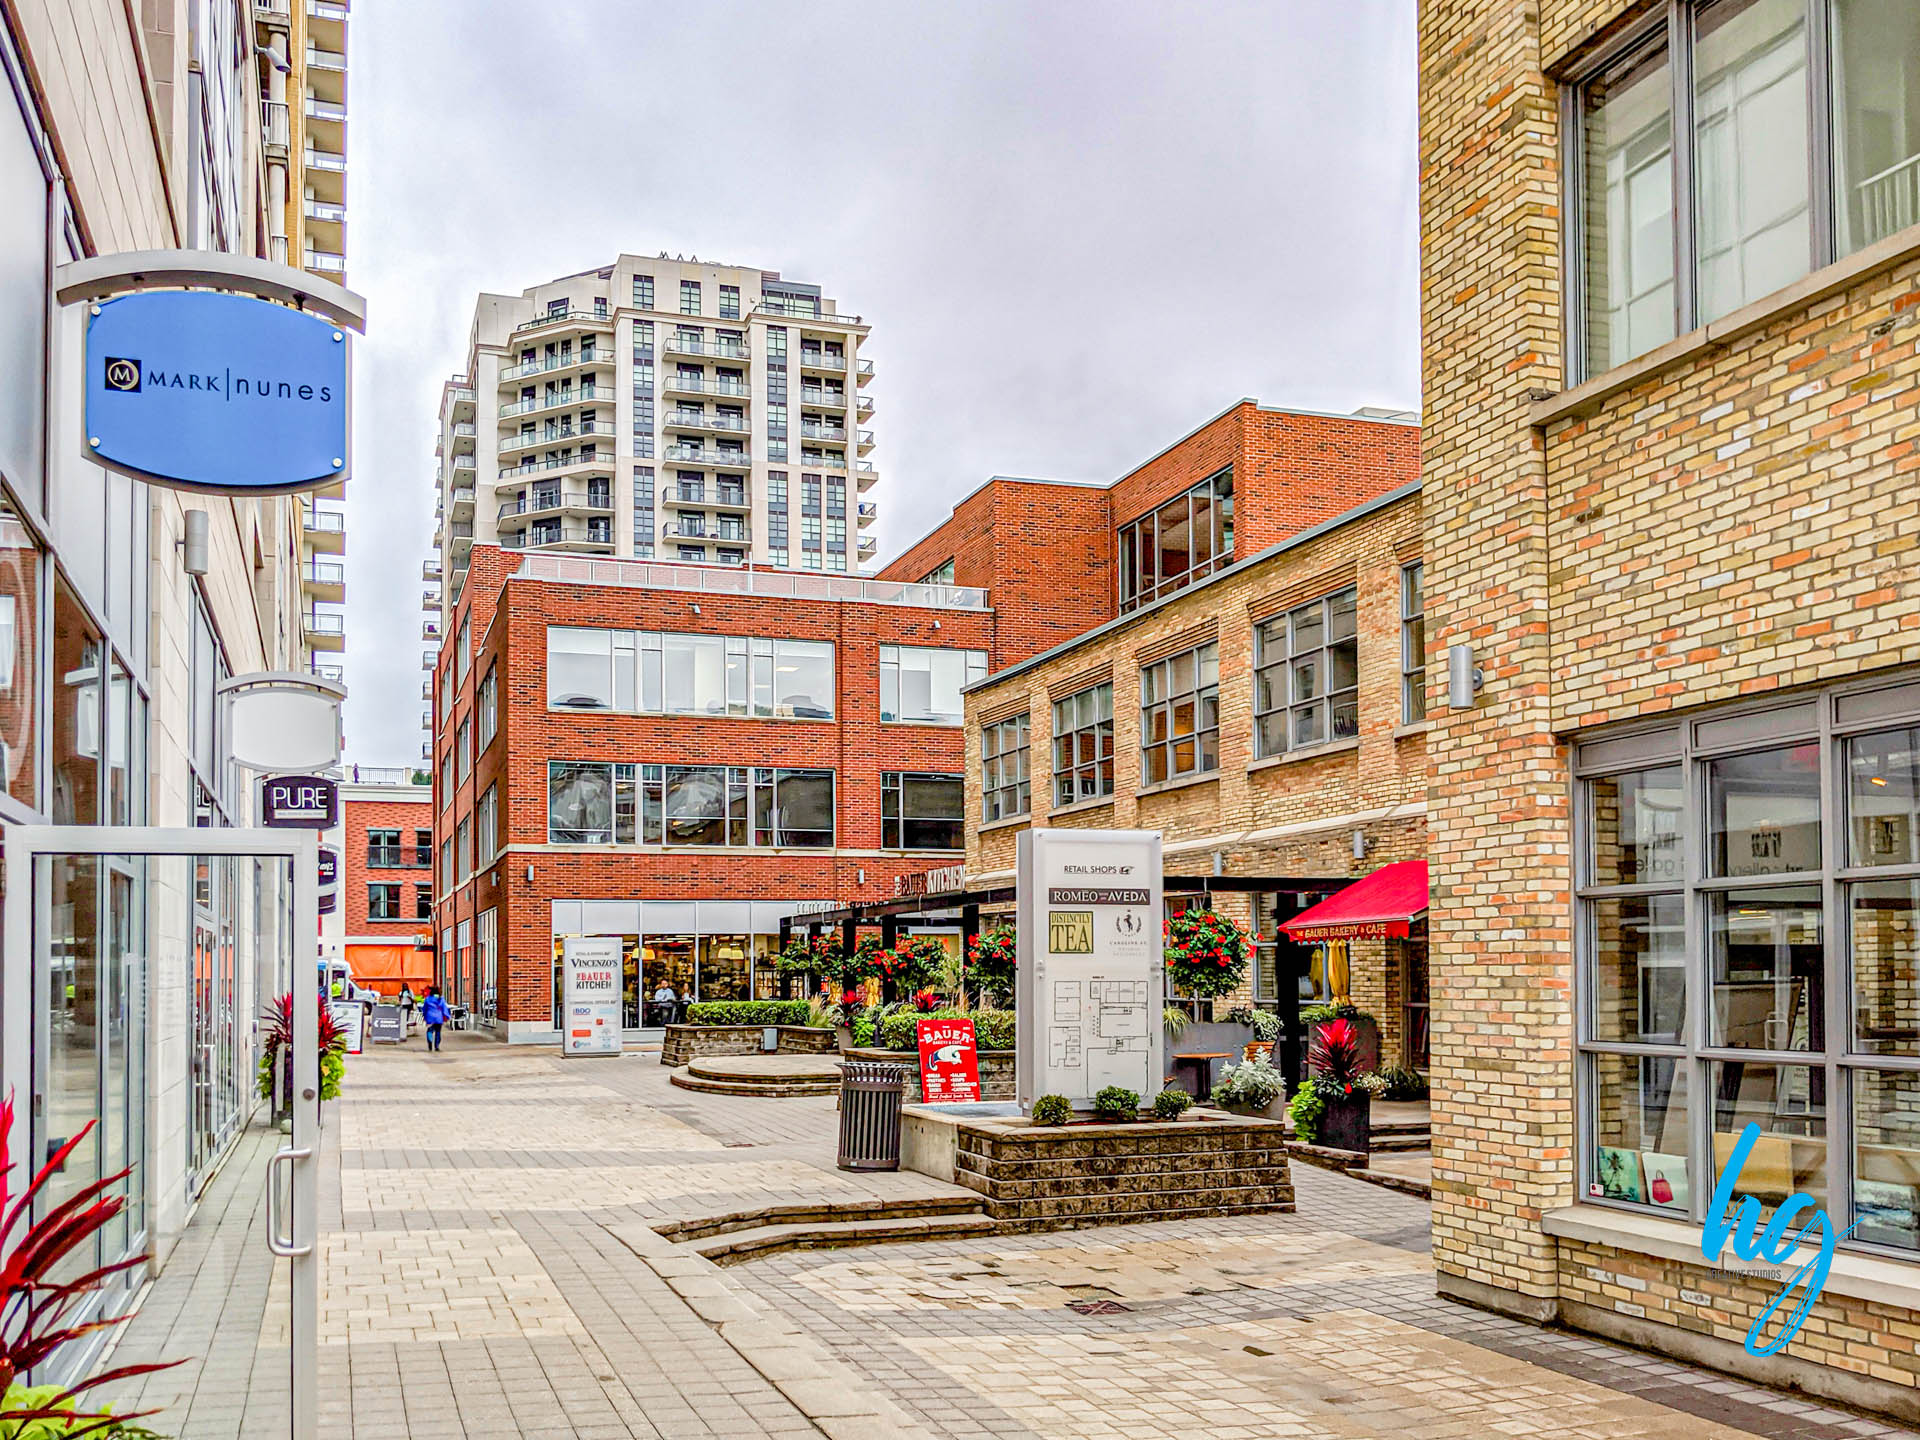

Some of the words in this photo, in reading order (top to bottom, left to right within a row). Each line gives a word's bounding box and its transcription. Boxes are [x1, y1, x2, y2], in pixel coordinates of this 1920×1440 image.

[148, 370, 221, 392] MARK
[236, 378, 331, 402] nunes
[272, 786, 328, 809] PURE
[1064, 865, 1088, 873] RETAIL
[1107, 891, 1147, 902] AVEDA
[1304, 927, 1329, 938] BAUER
[1329, 924, 1359, 937] BAKERY
[1051, 924, 1091, 952] TEA
[571, 958, 618, 968] VINCENZO'S
[581, 972, 612, 981] BAUER
[576, 980, 612, 990] KITCHEN
[923, 1029, 971, 1044] BAUER
